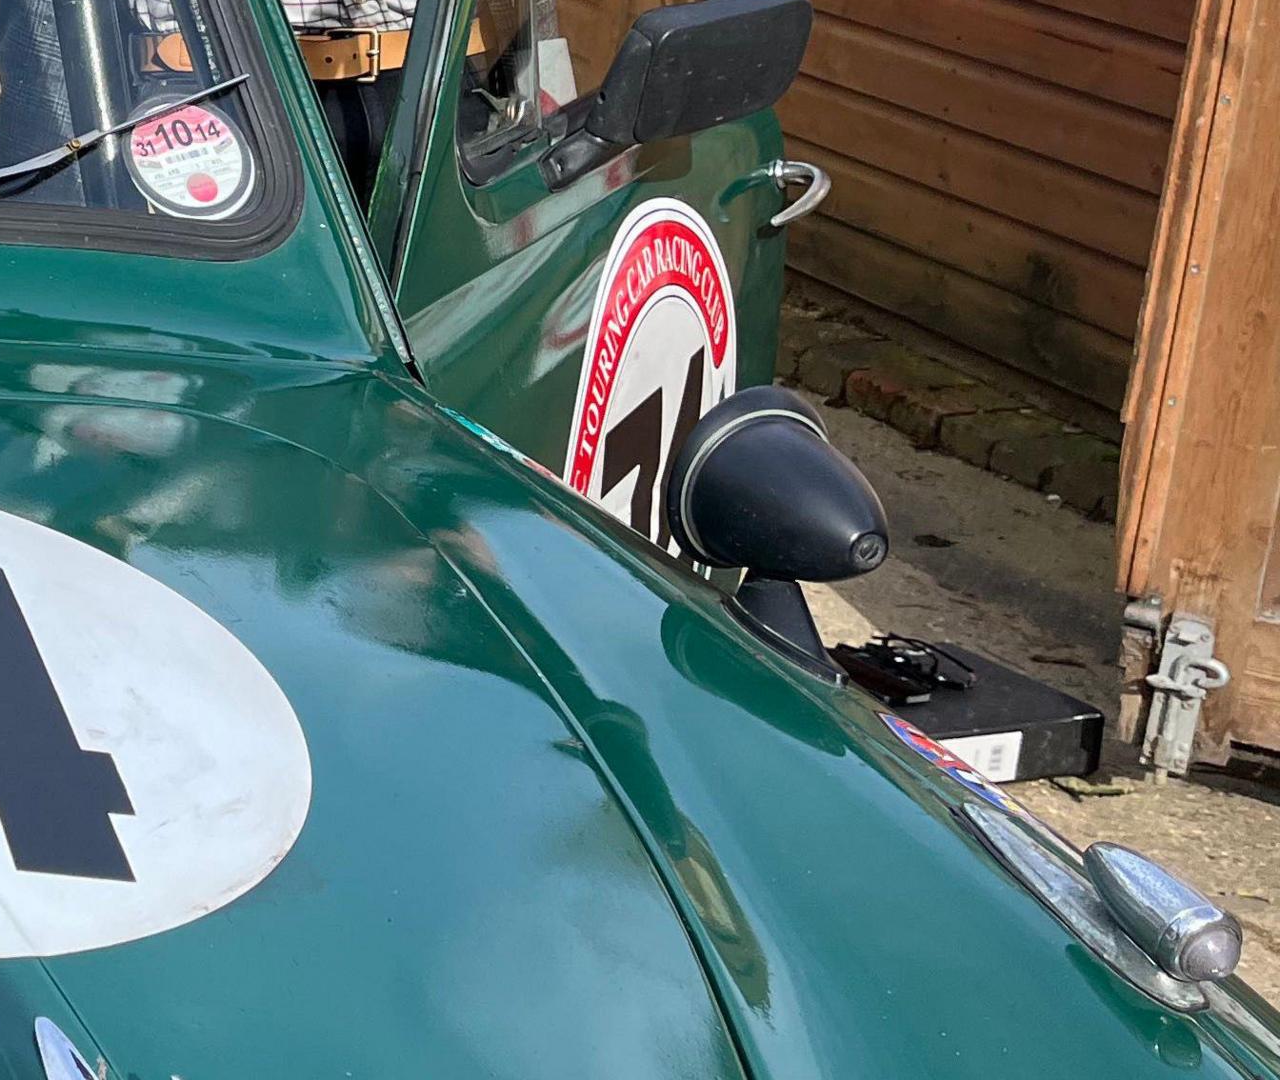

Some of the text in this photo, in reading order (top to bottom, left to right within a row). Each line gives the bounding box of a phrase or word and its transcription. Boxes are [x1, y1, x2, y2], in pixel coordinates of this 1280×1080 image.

[136, 140, 156, 157] 31
[155, 119, 193, 150] 10
[195, 121, 221, 141] 14
[580, 235, 725, 461] TOURING CAR RACING CLUB
